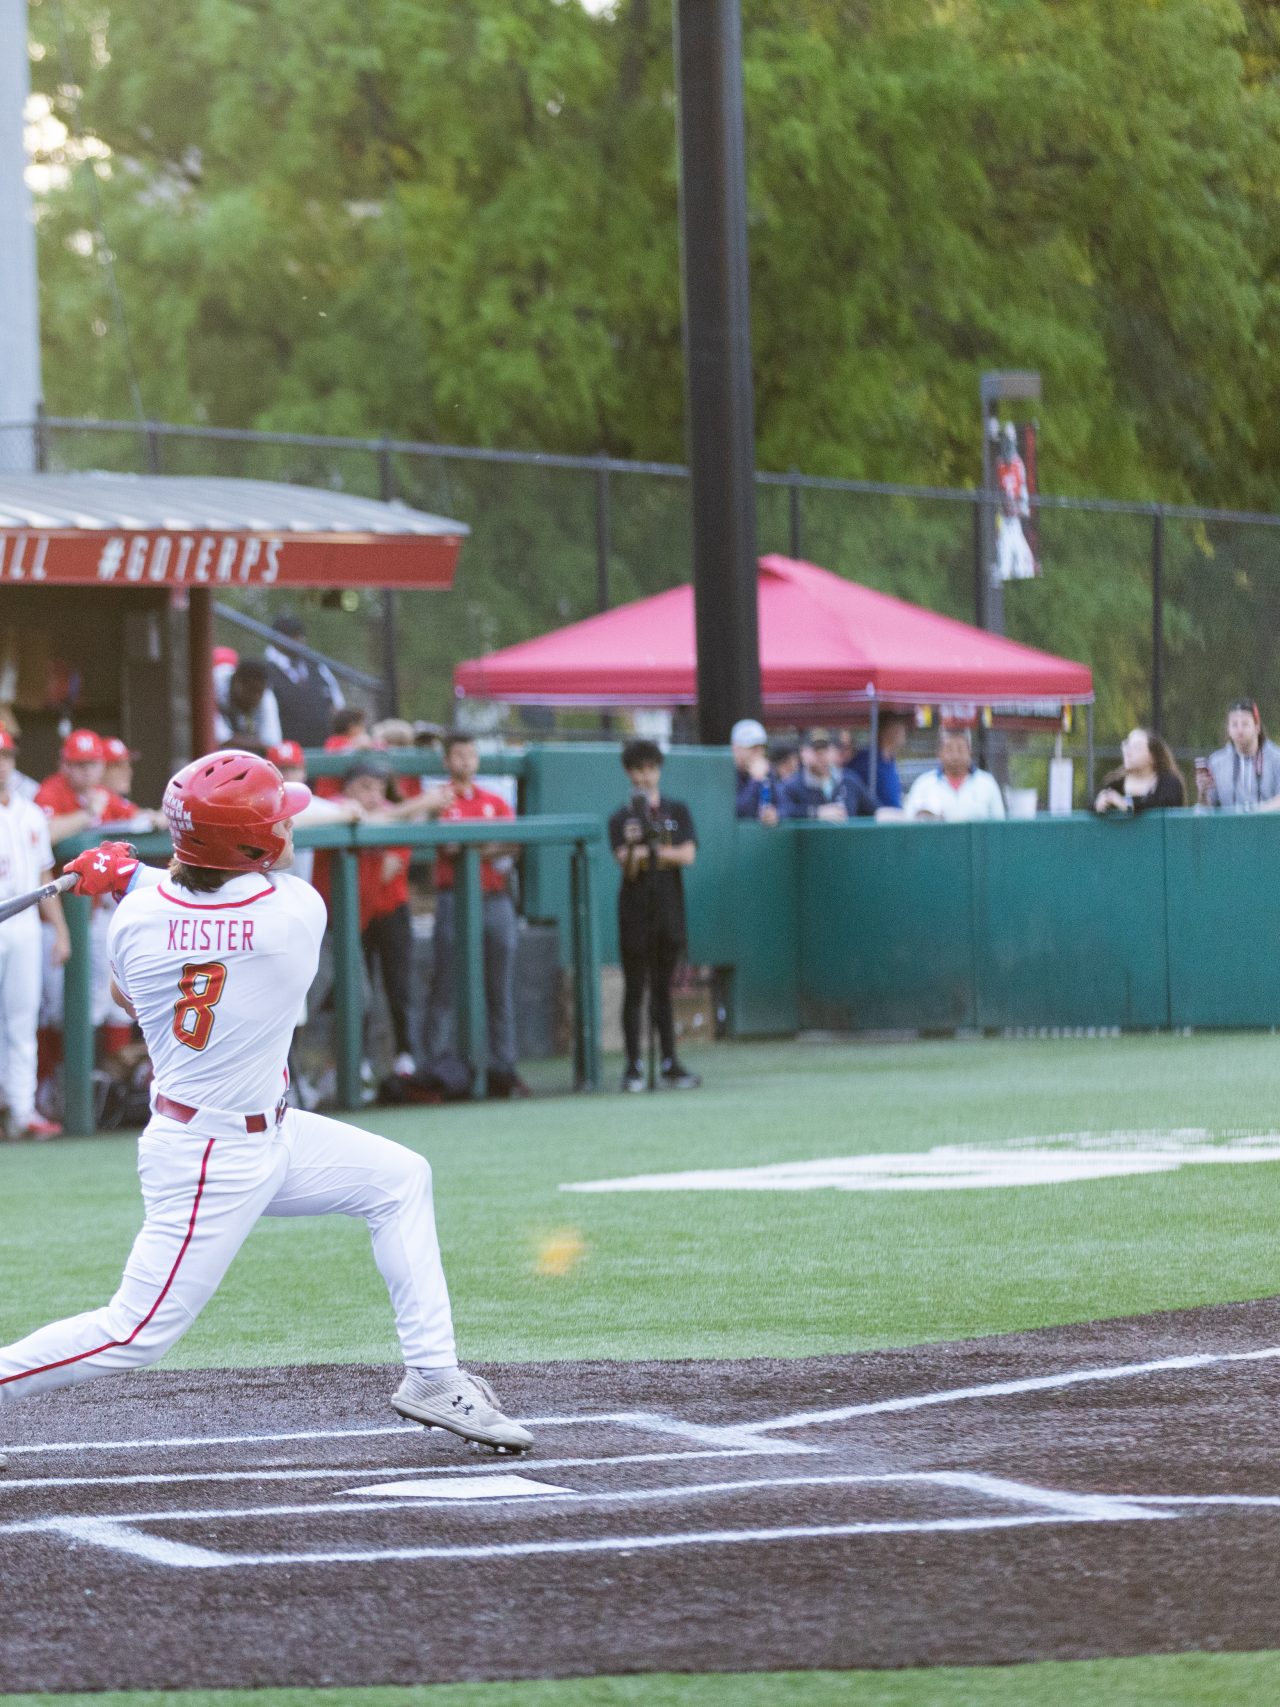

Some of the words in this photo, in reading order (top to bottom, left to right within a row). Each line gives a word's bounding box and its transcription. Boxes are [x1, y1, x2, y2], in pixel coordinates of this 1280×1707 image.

[96, 535, 284, 584] #GOTERPS
[168, 919, 254, 951] KEISTER
[172, 961, 227, 1052] 8
